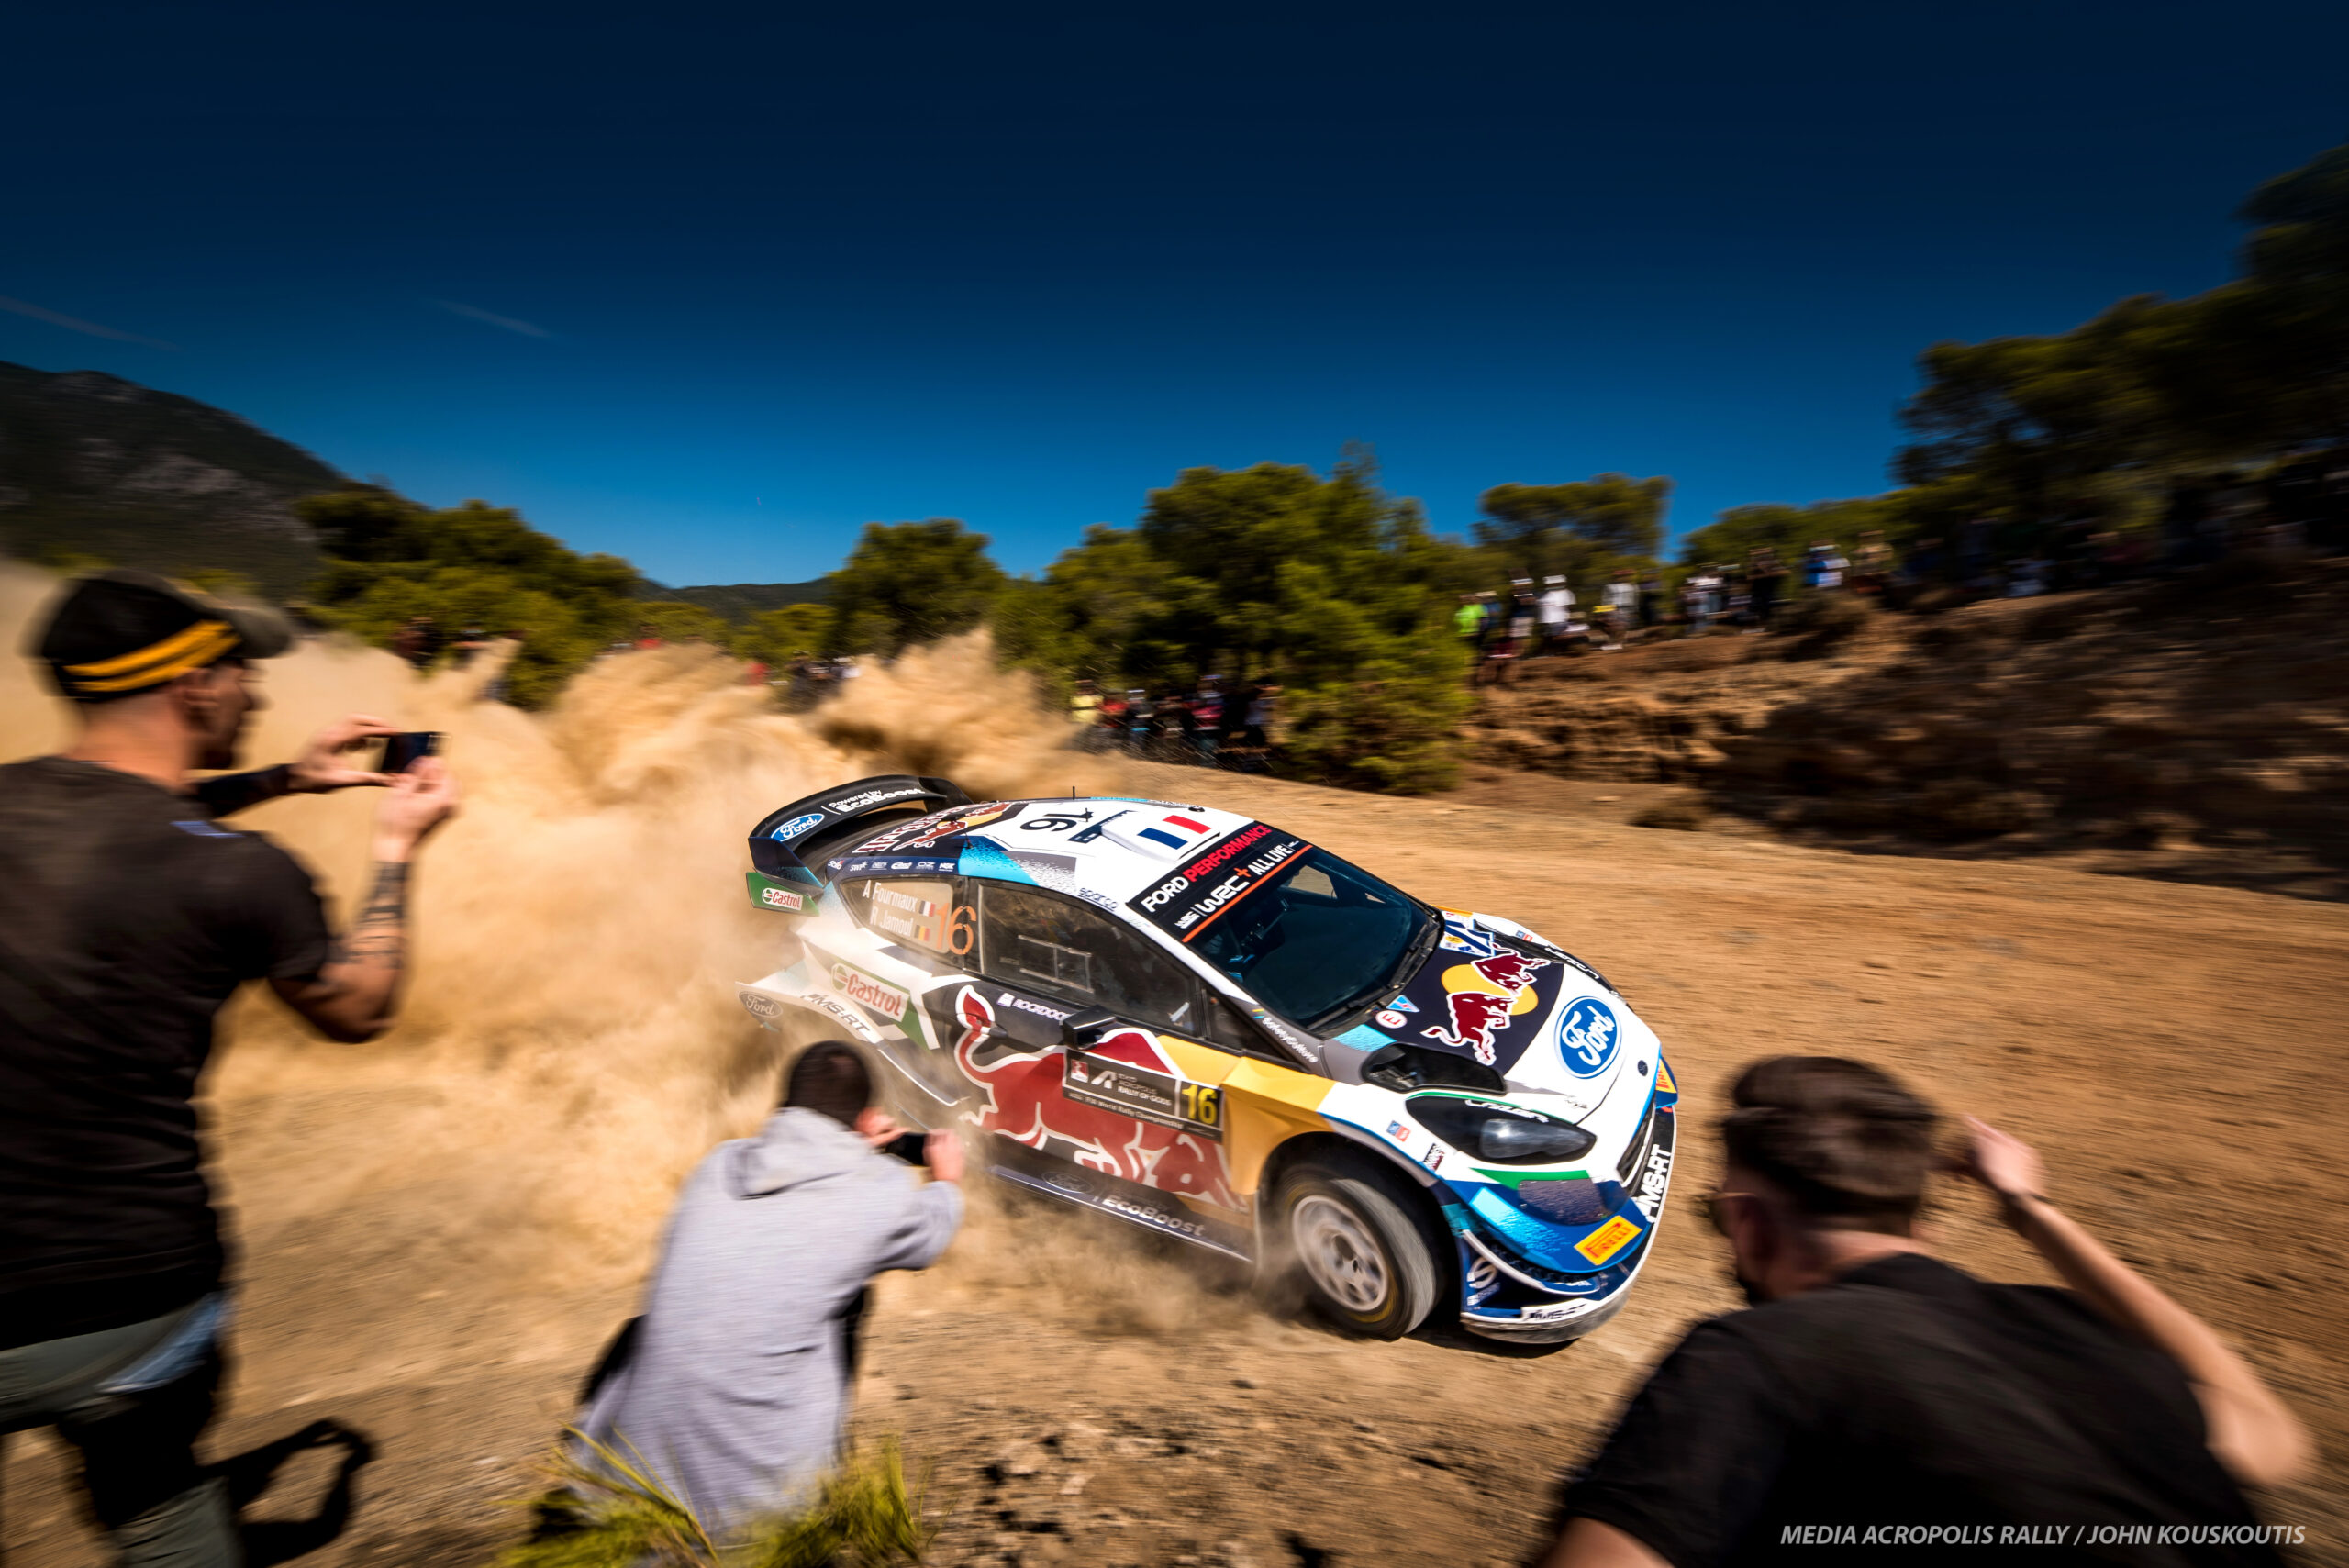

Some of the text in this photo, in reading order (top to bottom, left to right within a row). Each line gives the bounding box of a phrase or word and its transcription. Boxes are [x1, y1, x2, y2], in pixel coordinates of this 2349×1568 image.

[829, 789, 882, 807] Powered by
[836, 788, 926, 813] EcoBoost
[780, 817, 818, 839] Ford
[1141, 876, 1190, 912] FORD
[1182, 825, 1274, 882] PERFORMANCE
[1248, 858, 1275, 876] ALL
[1264, 843, 1293, 862] LIVE
[773, 891, 801, 908] Castrol
[863, 880, 918, 912] A Fourmaux
[1078, 887, 1119, 910] sparco
[869, 906, 914, 937] R Jamoul
[936, 903, 977, 955] 16
[746, 996, 775, 1016] Ford
[847, 973, 901, 1017] Castrol
[1562, 1005, 1615, 1066] Ford
[1182, 1084, 1218, 1125] 16
[1102, 1194, 1207, 1237] EcoBoost
